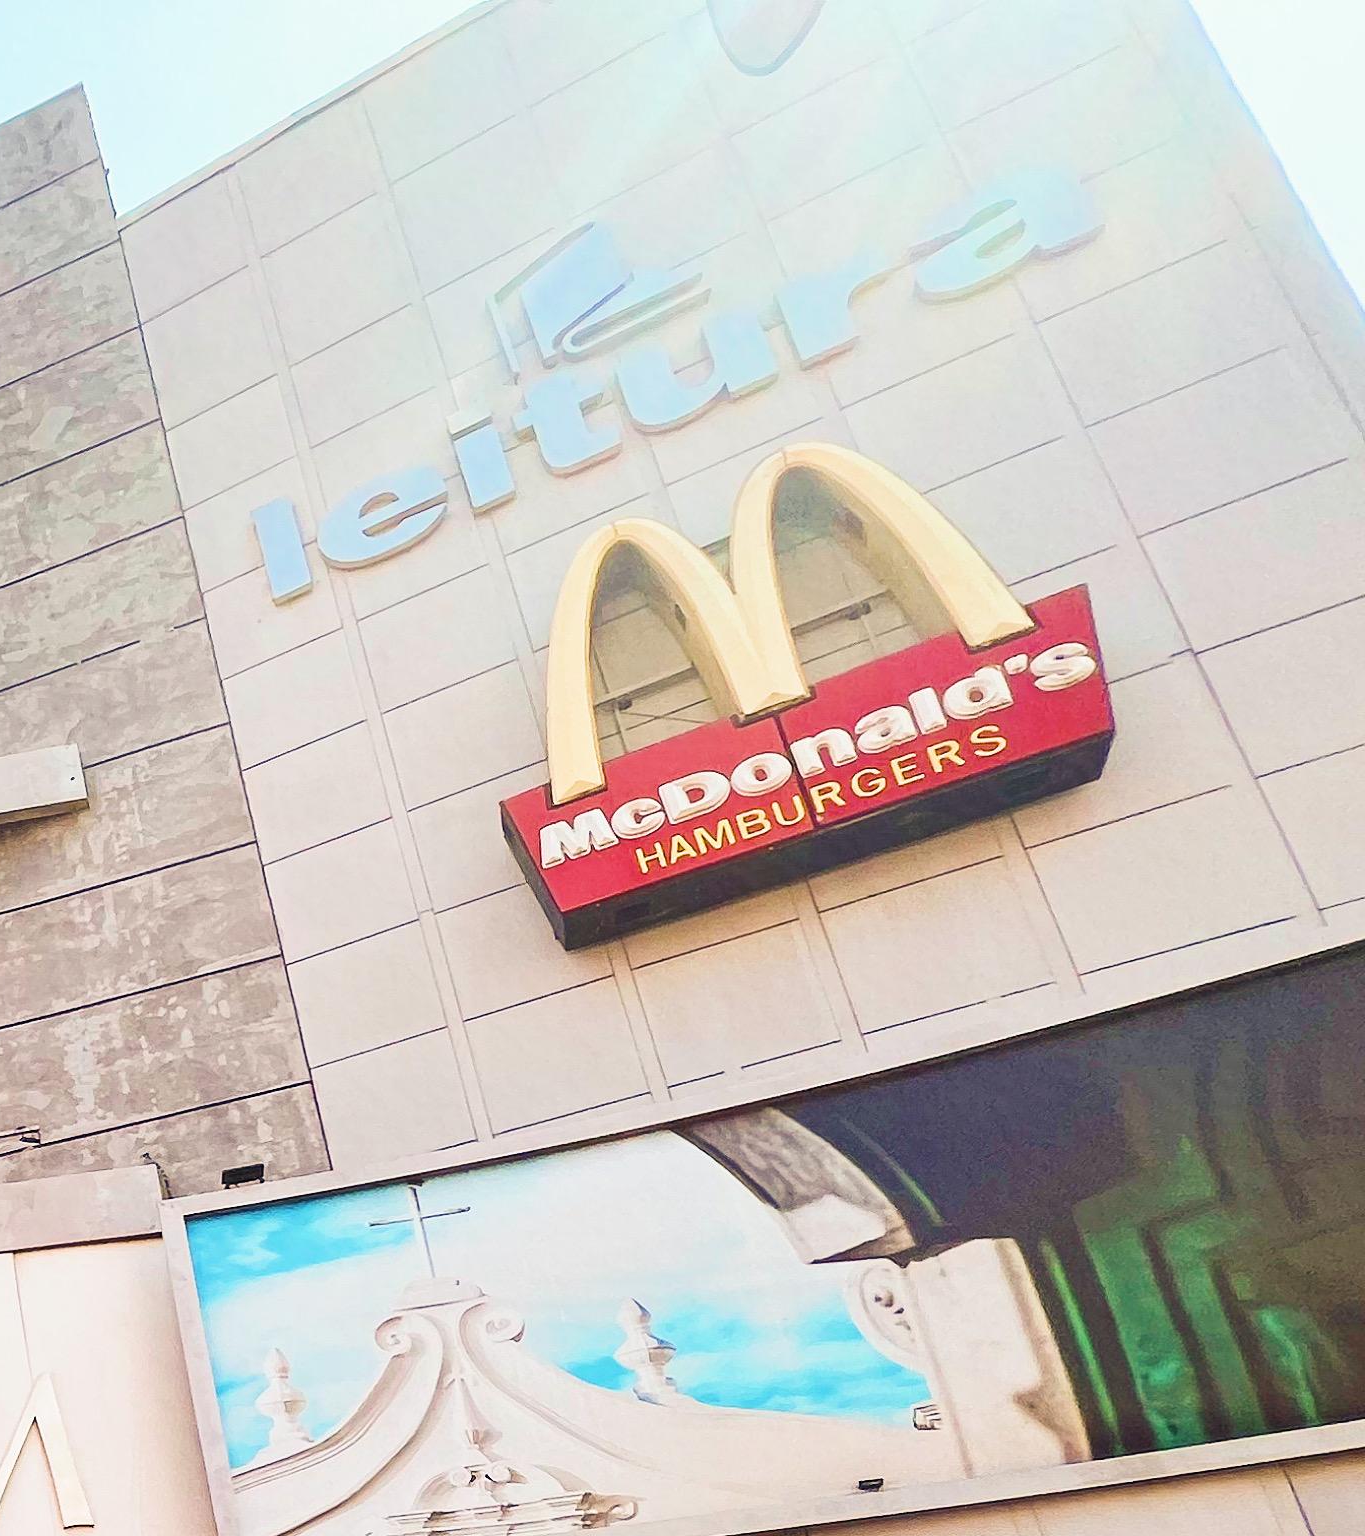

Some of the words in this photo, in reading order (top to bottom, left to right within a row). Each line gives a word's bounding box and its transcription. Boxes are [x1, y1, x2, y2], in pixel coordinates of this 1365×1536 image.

[250, 172, 1105, 605] leitura
[539, 638, 1098, 871] McDonald's
[633, 723, 1010, 875] HAMBURGERS
